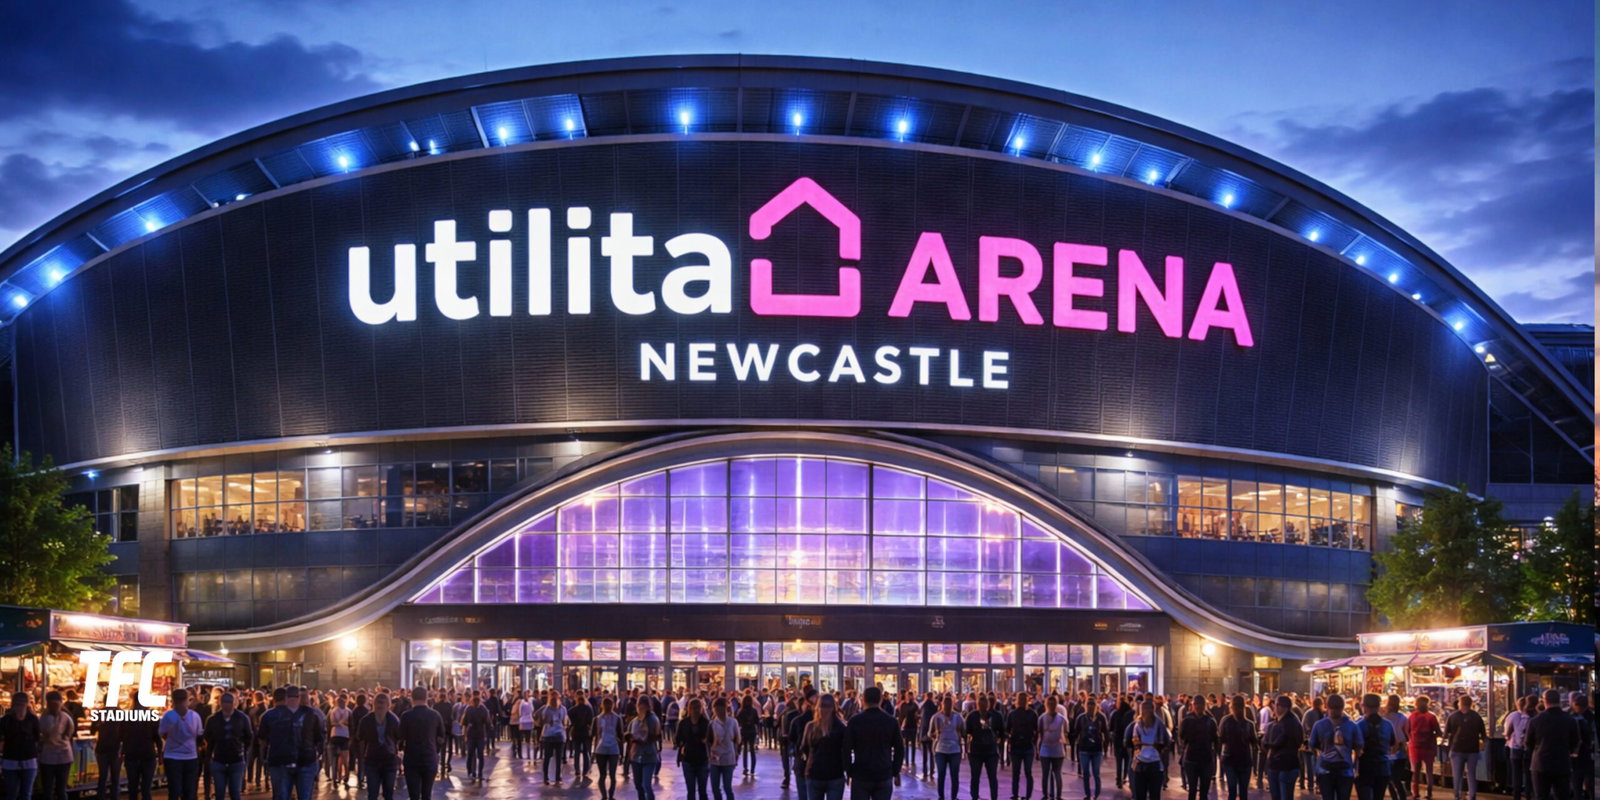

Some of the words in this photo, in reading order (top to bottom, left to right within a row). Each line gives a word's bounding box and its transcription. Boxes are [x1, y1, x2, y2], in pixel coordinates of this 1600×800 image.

[349, 207, 732, 325] utilita
[887, 232, 1254, 347] ARENA
[640, 342, 1009, 389] NEWCASTLE
